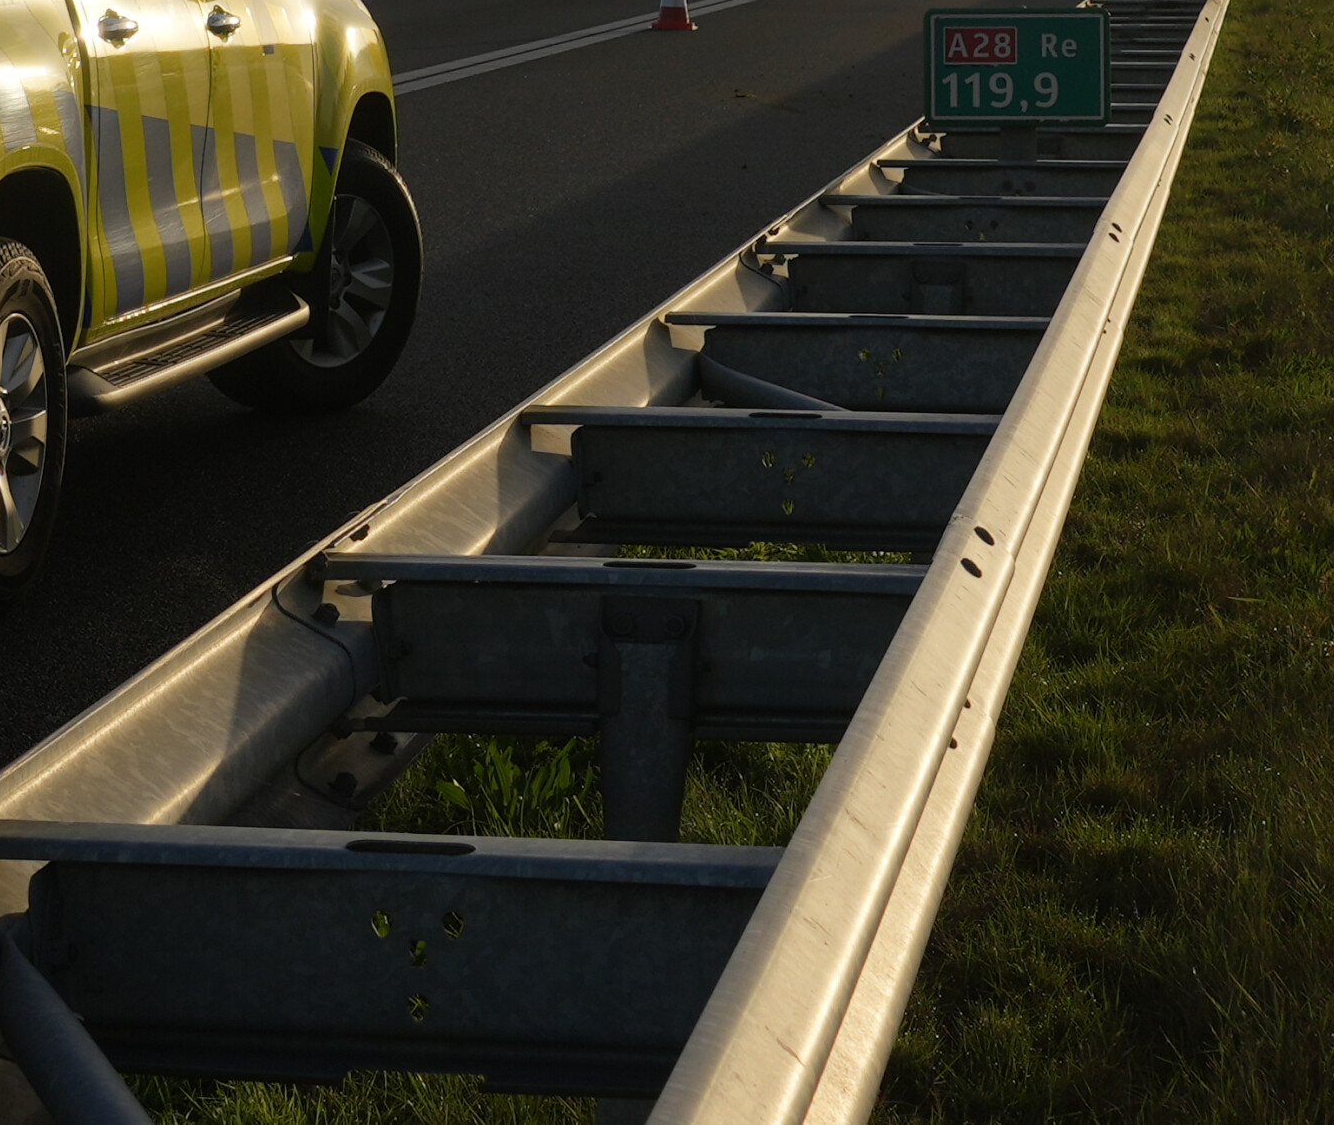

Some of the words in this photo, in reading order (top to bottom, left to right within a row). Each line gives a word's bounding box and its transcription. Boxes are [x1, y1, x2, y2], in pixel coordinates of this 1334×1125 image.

[948, 33, 1012, 58] A28
[1041, 33, 1078, 58] Re
[941, 71, 1060, 114] 119,9
